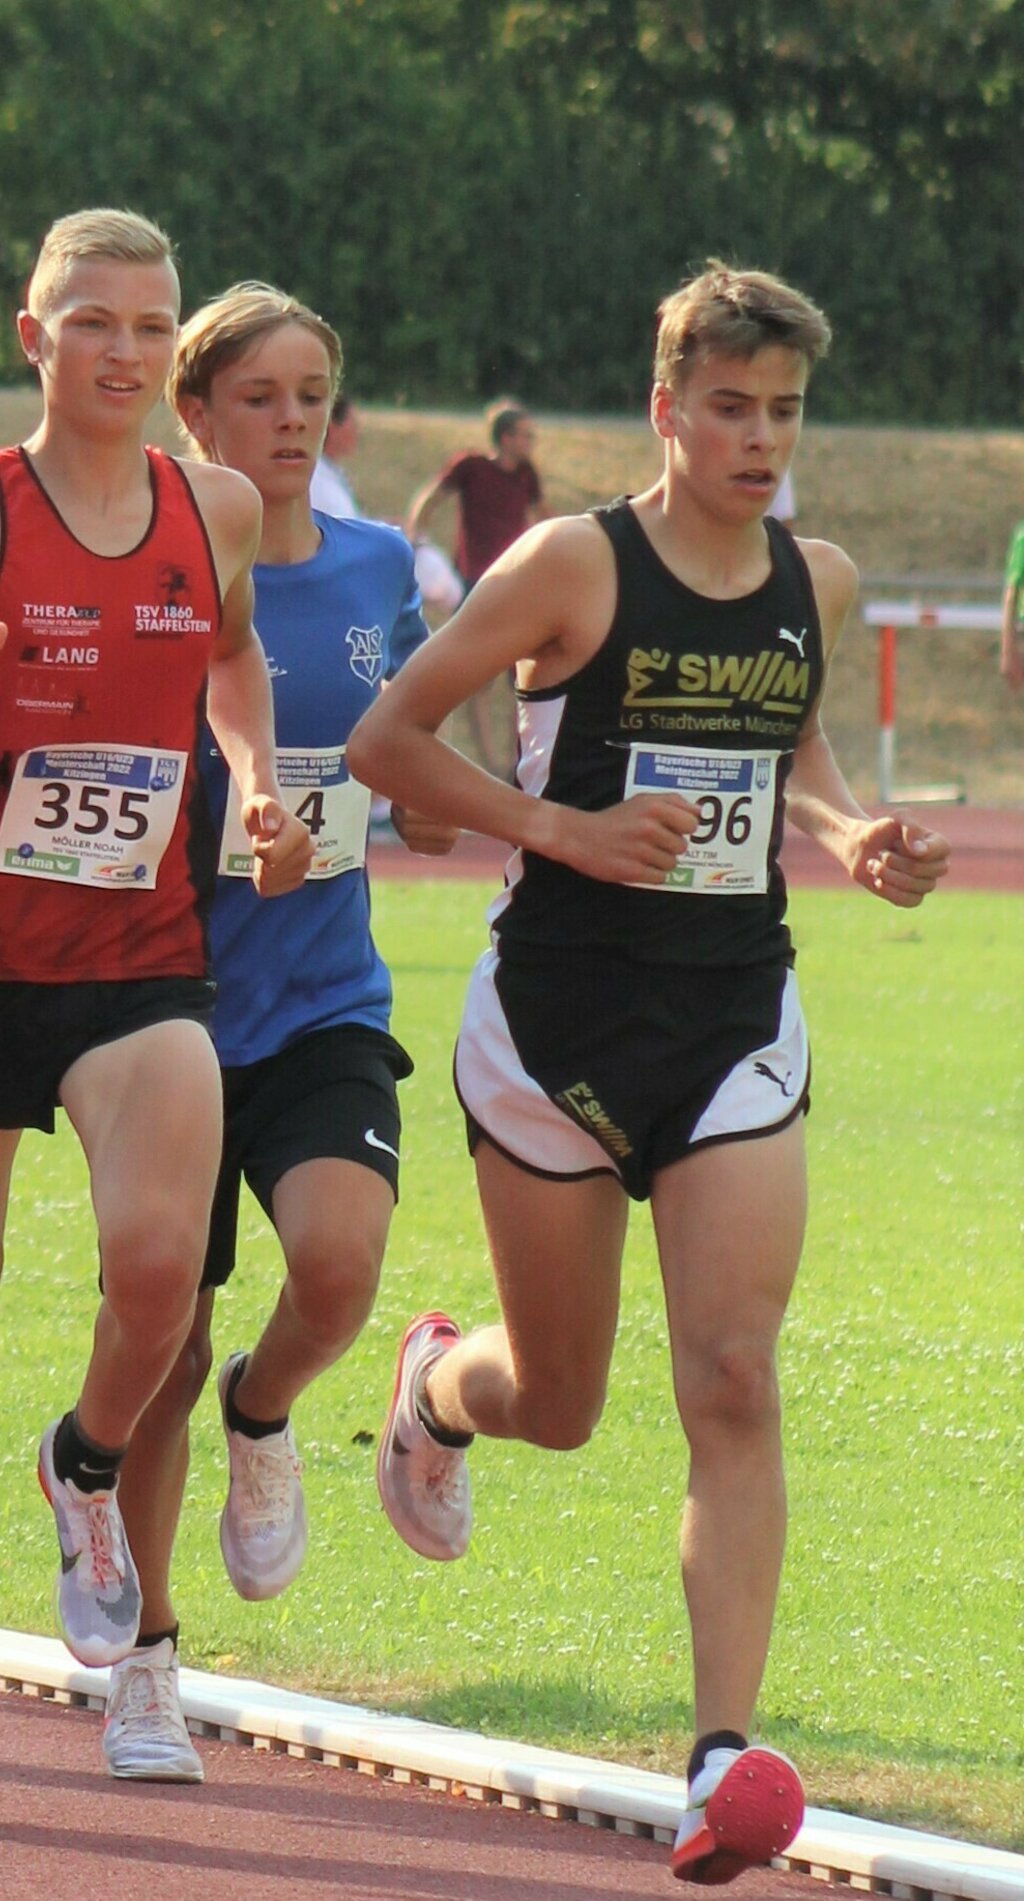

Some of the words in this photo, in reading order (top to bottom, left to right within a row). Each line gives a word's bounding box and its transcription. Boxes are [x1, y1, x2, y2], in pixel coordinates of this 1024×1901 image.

[134, 605, 159, 618] TSV
[163, 606, 193, 619] 1860
[135, 619, 211, 632] STAFFELSTEIN
[43, 647, 99, 664] LANG
[16, 699, 74, 709] OBERMAIN
[619, 713, 643, 729] LG
[650, 713, 742, 732] Stadtwerke
[45, 759, 106, 771] Meisterschaft
[107, 763, 132, 774] 2022
[654, 754, 707, 768] Bayerische
[63, 769, 107, 780] Kitzingen
[655, 765, 718, 779] Meisterschaft
[677, 777, 719, 789] Kitzingen
[34, 782, 151, 841] 355
[690, 795, 753, 846] 96
[52, 836, 91, 849] MÖLLER
[93, 843, 124, 855] NOAH
[11, 855, 54, 870] erima
[234, 859, 253, 870] eri
